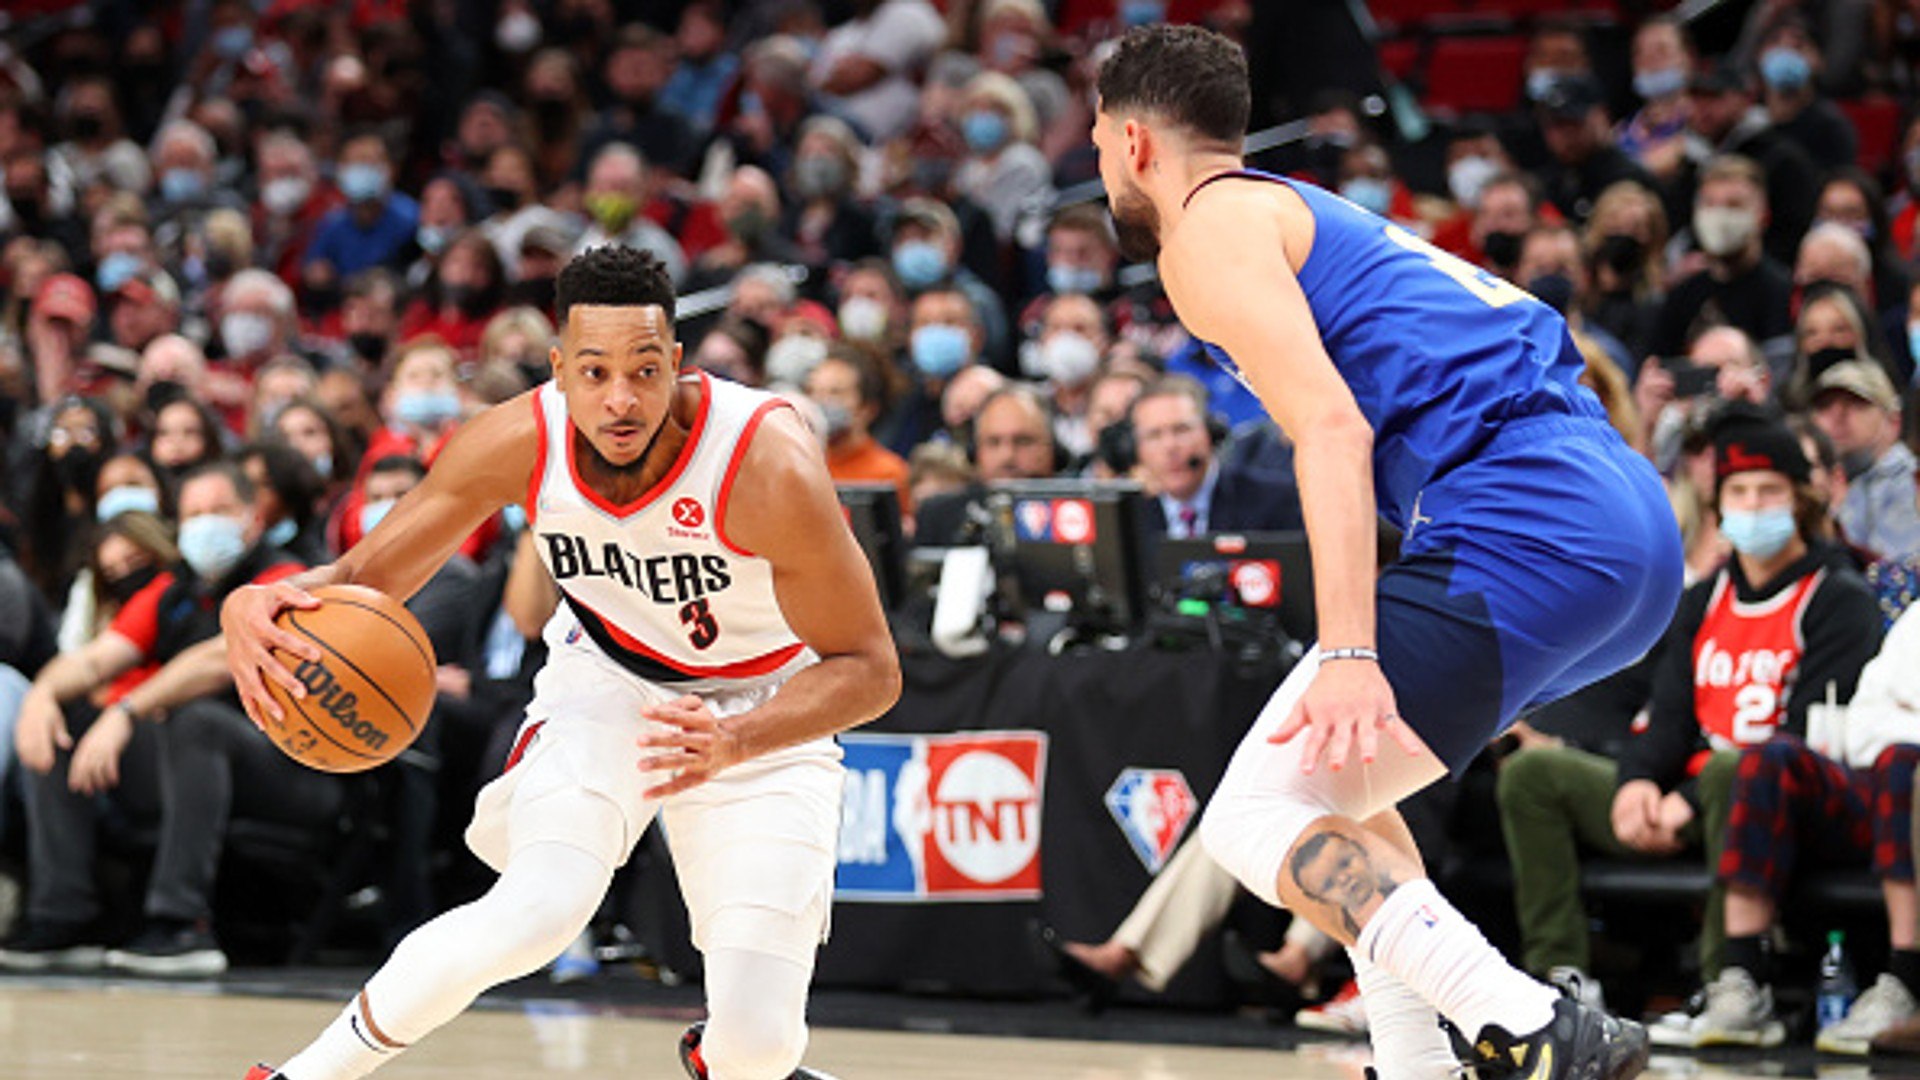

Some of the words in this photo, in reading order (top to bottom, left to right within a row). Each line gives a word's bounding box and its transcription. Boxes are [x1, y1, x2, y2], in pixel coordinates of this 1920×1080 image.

[679, 598, 719, 650] 3
[294, 659, 389, 751] Wilson
[838, 768, 887, 865] BA
[935, 799, 1038, 845] TNT
